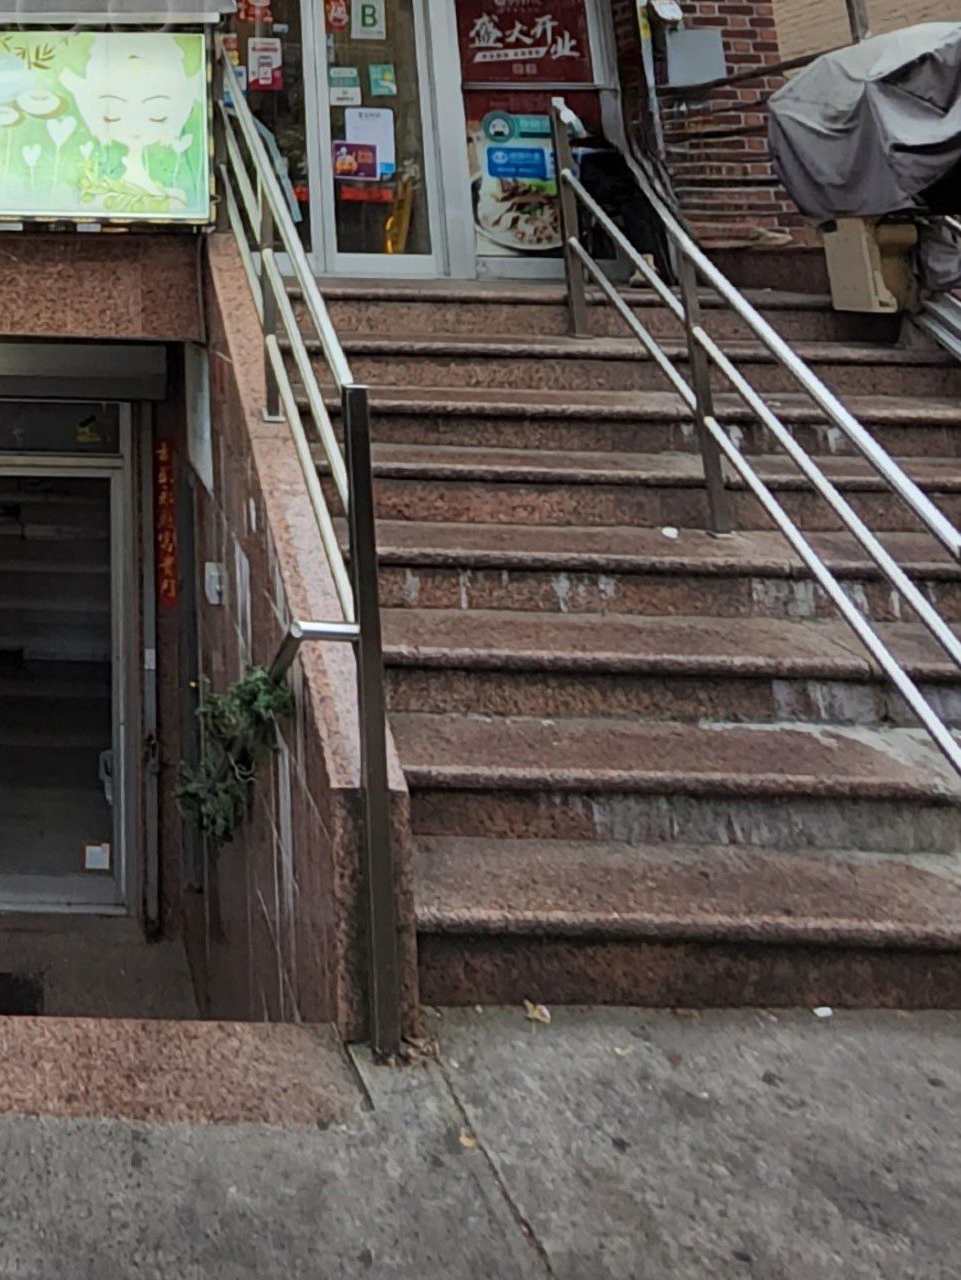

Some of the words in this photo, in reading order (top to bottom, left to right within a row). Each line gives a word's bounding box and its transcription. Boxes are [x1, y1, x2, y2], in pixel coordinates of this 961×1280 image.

[360, 3, 379, 28] B
[468, 13, 581, 59] 盛大开业
